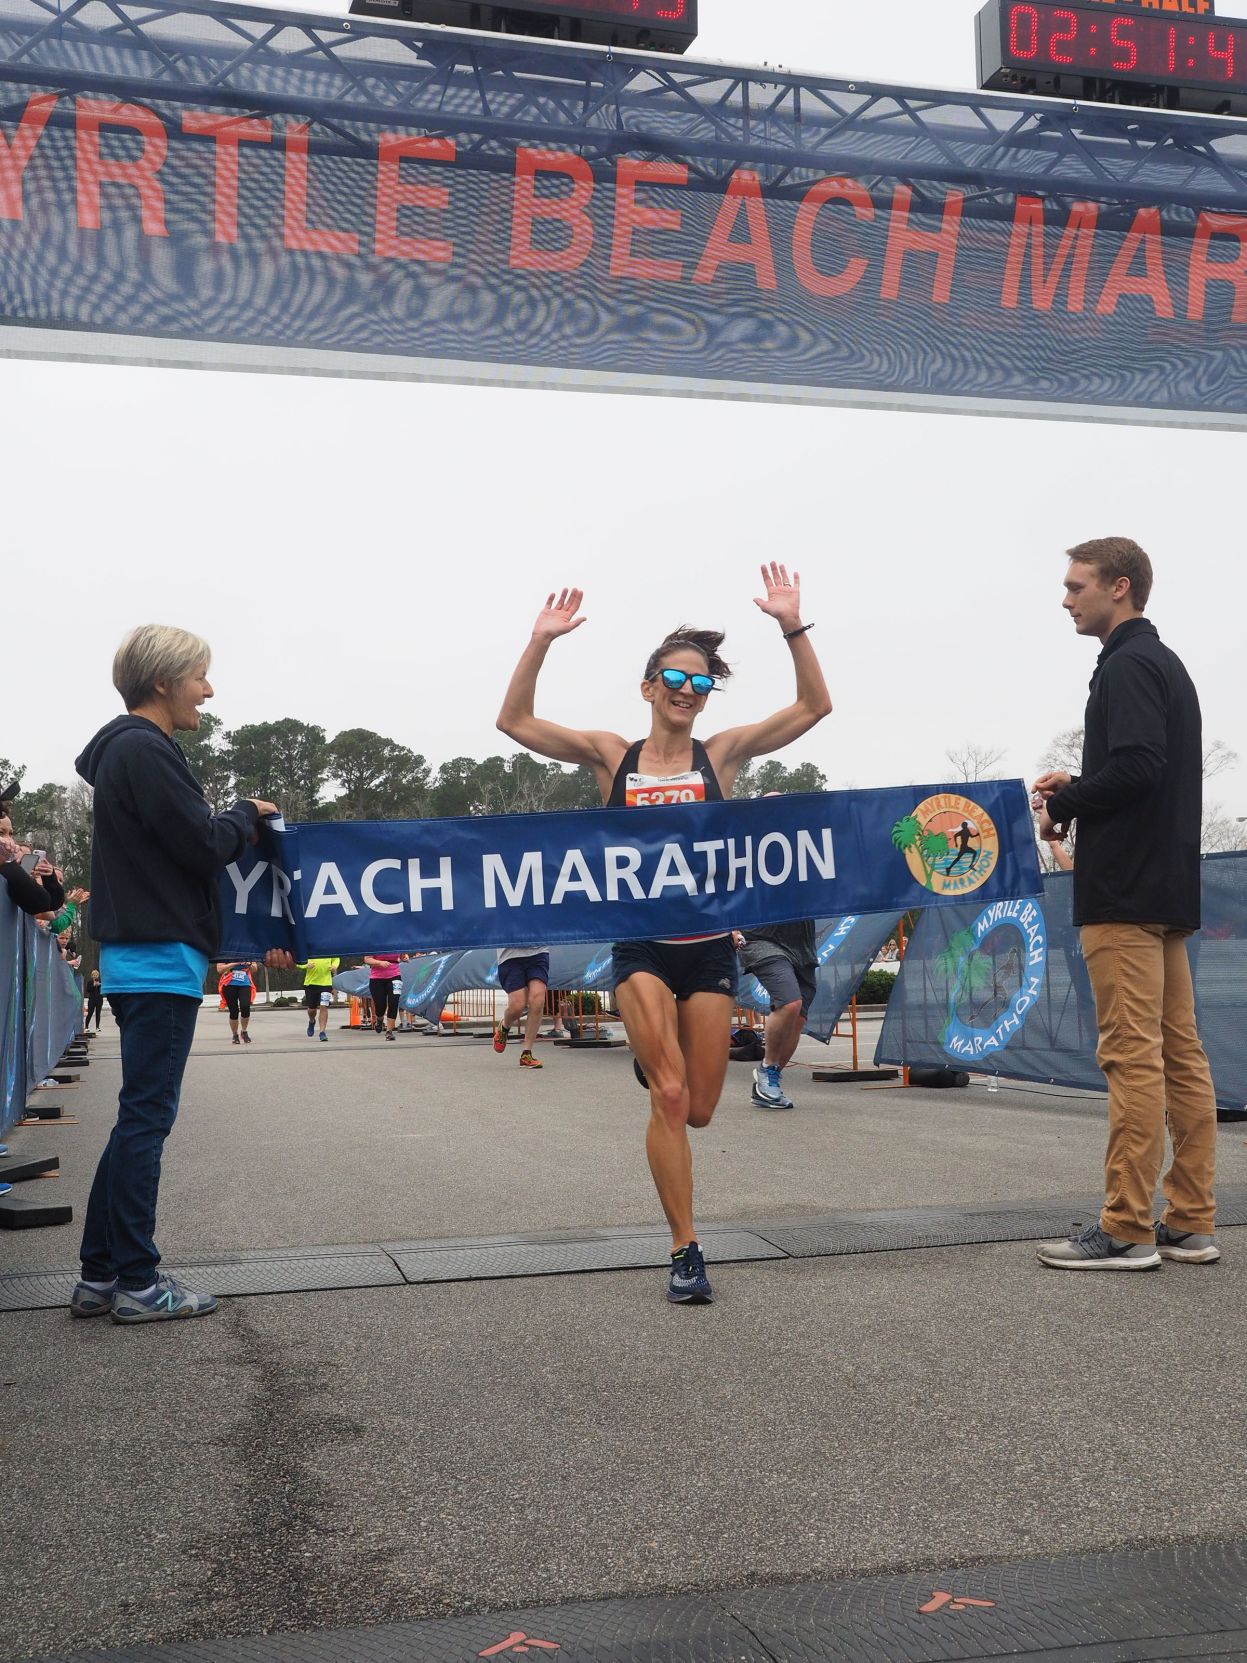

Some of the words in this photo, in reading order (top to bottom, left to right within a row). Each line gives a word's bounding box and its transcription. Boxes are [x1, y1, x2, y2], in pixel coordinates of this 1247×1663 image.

[1009, 5, 1235, 79] 02:51:4
[509, 146, 964, 304] BEACH
[1000, 196, 1247, 323] MAR
[918, 796, 961, 819] MYRTLE
[962, 799, 996, 840] BEACH
[304, 857, 454, 918] ACH
[482, 827, 836, 908] MARATHON
[941, 850, 994, 891] MARATHON
[977, 899, 1023, 938] MYRTLE
[1019, 902, 1043, 966] BEACH
[949, 977, 1038, 1055] MARATHON
